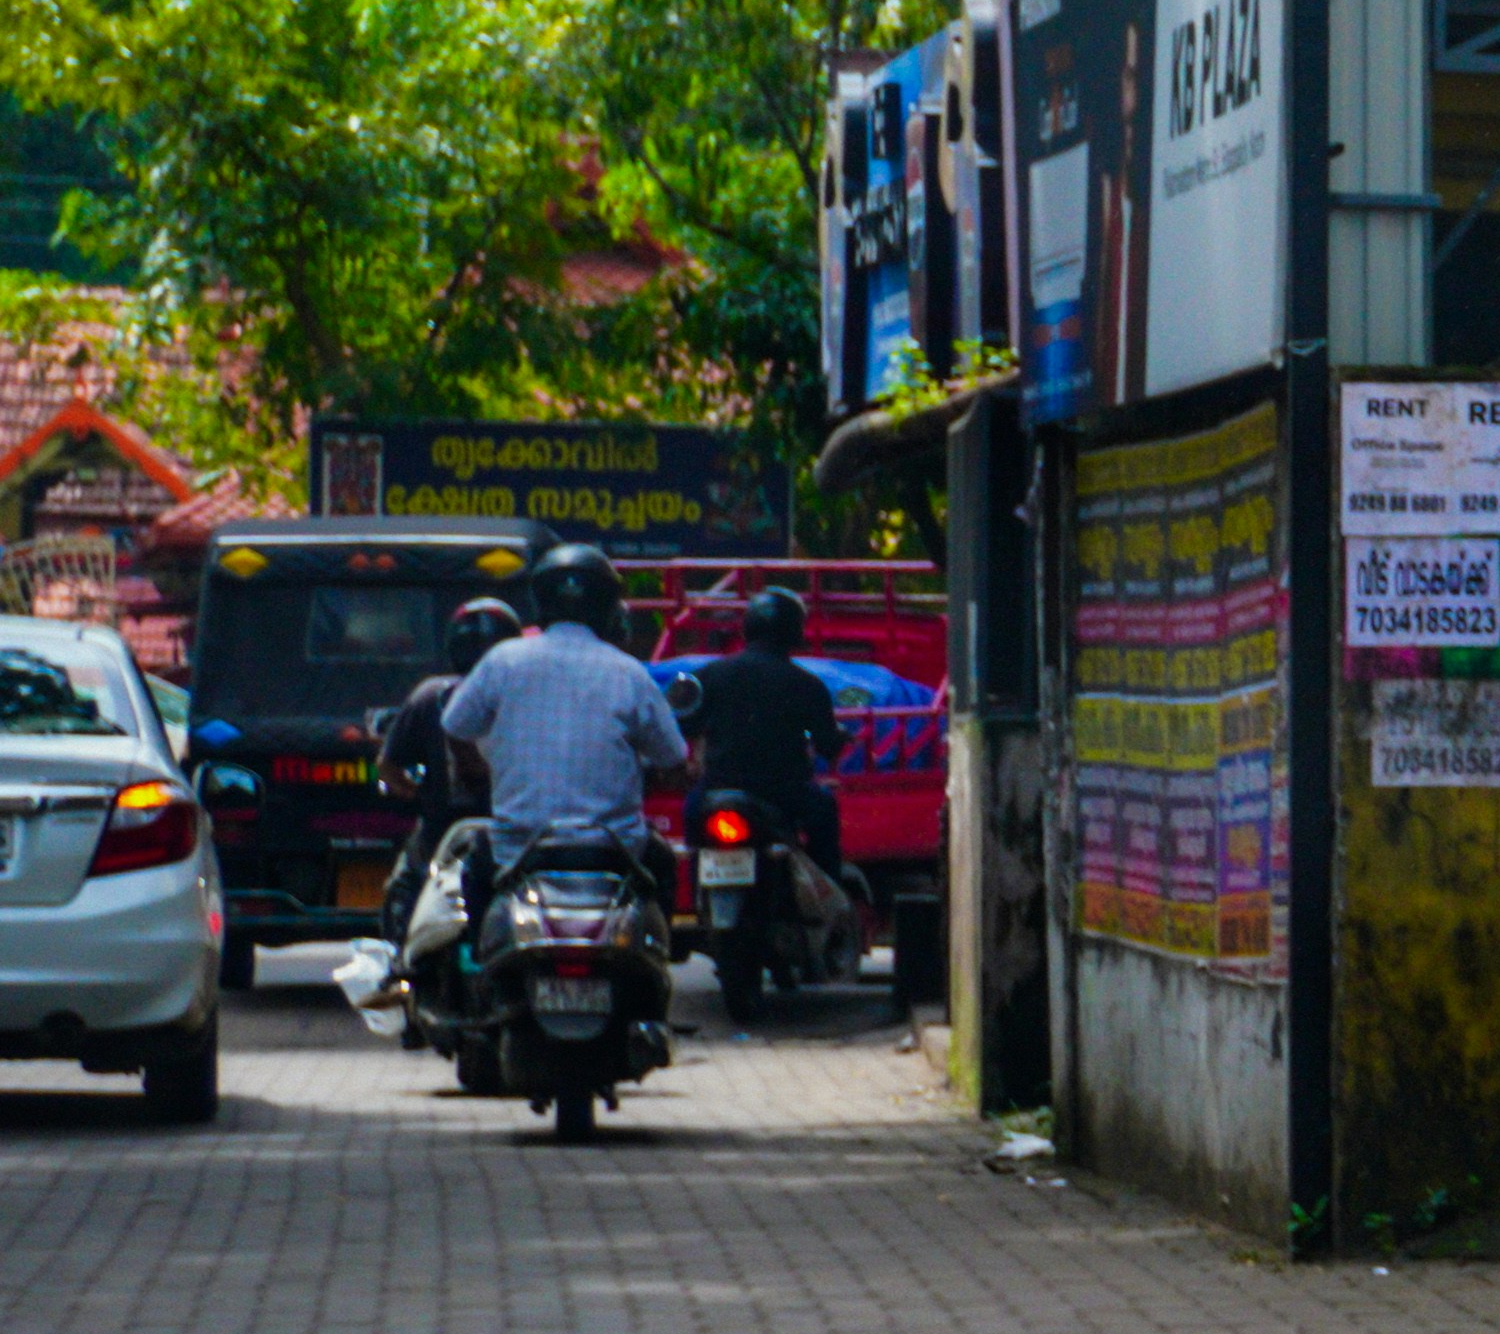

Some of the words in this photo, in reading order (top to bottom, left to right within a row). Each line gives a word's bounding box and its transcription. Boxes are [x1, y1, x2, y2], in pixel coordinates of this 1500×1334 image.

[1169, 19, 1197, 141] KB
[1366, 398, 1429, 418] RENT
[1356, 607, 1497, 634] 7034185823
